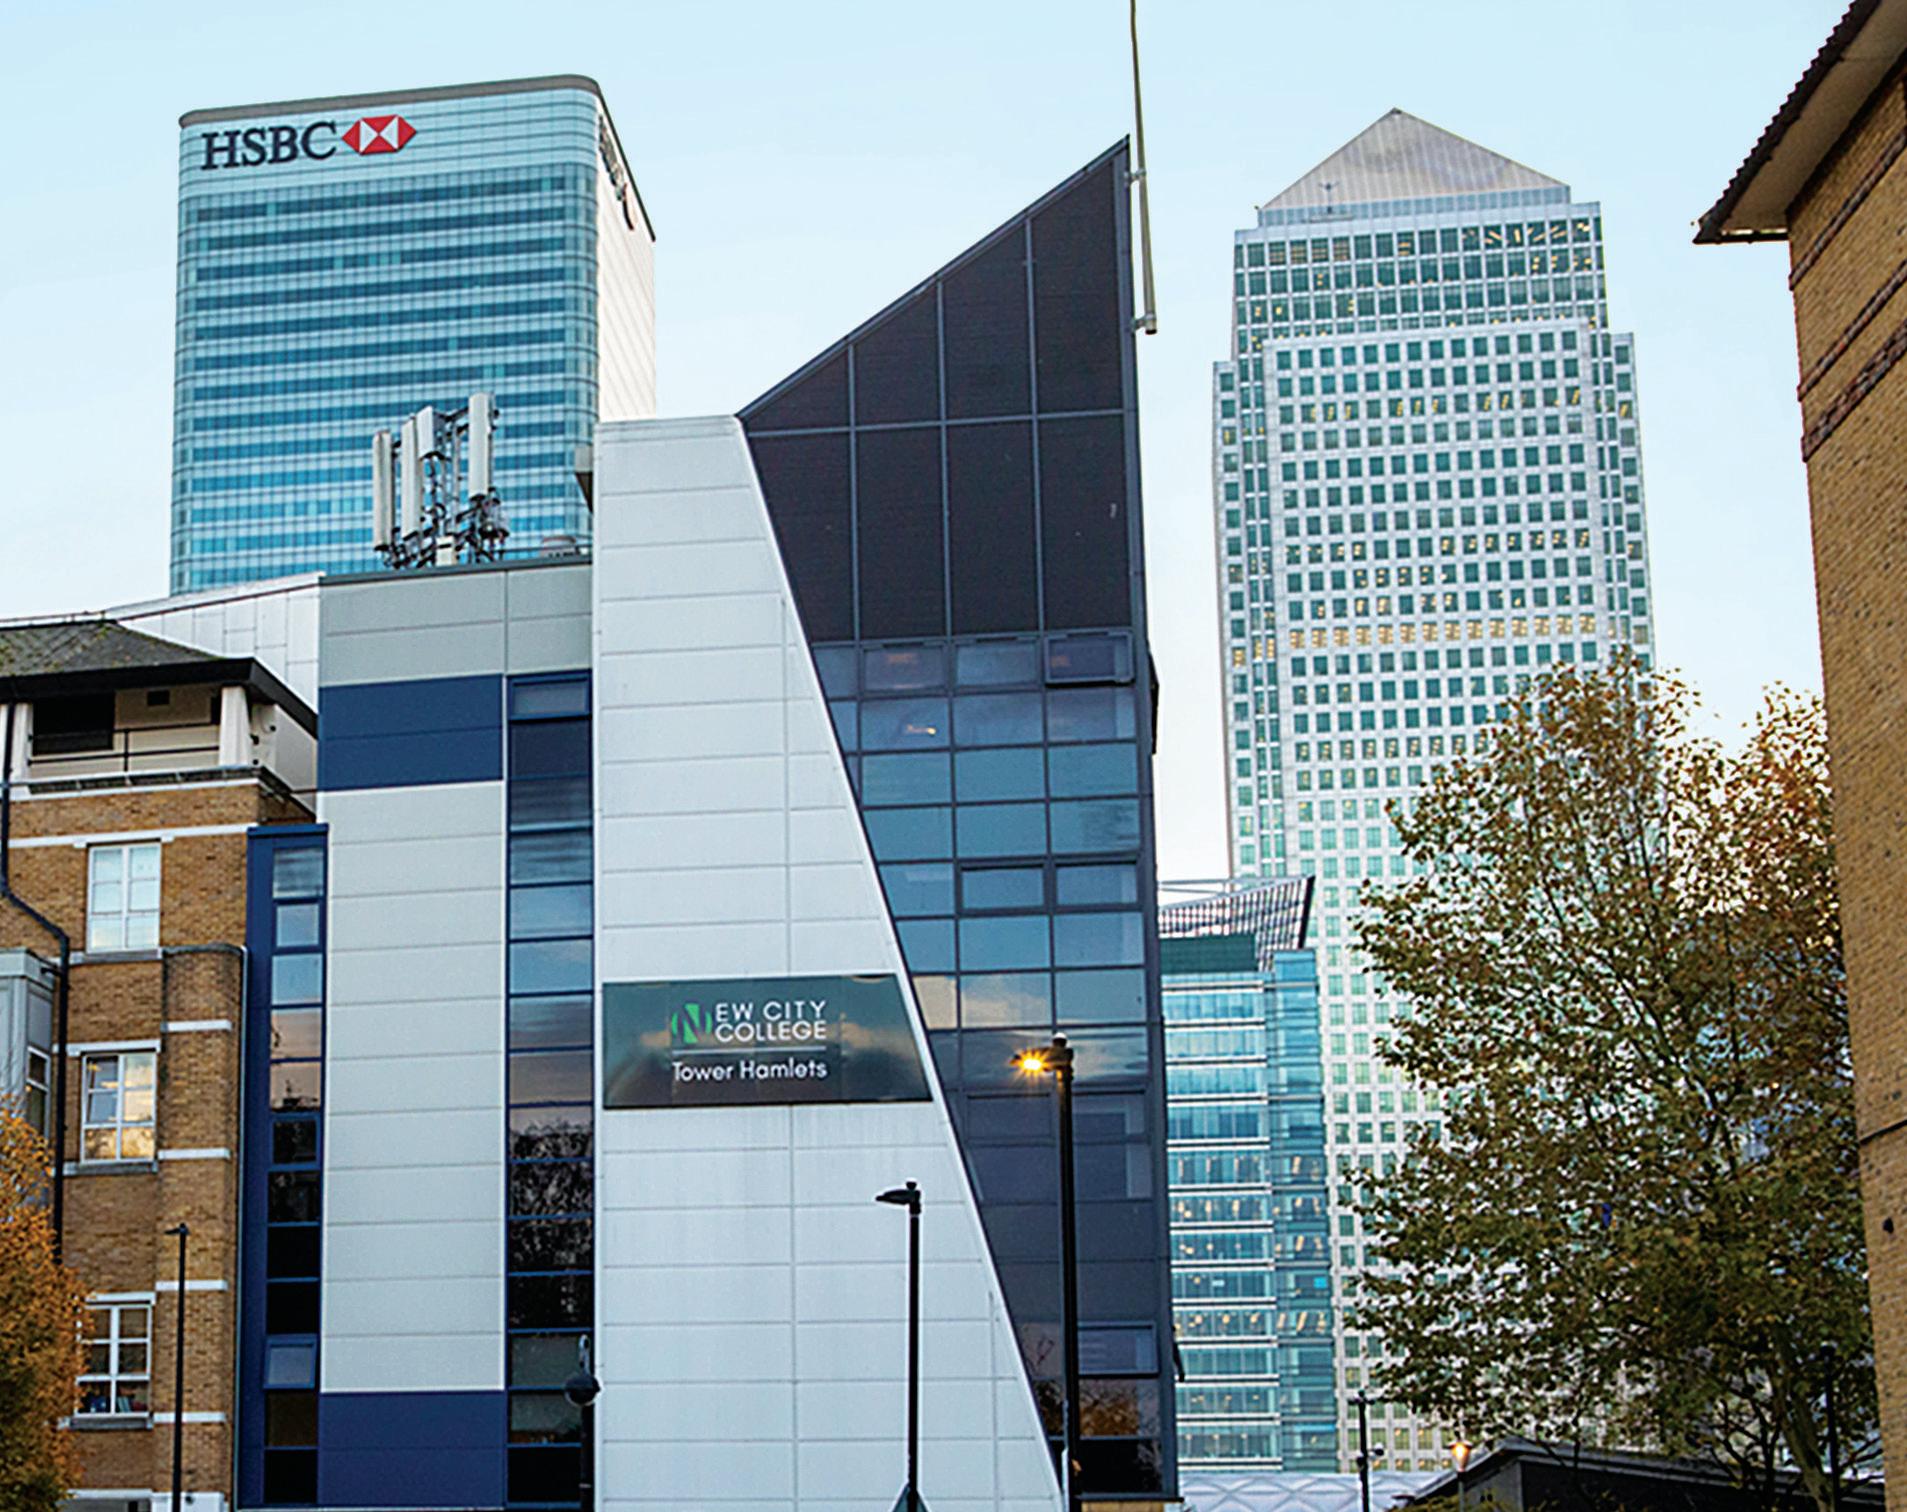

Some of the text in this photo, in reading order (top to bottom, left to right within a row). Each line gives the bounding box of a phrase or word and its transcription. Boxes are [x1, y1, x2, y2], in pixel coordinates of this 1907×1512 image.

[201, 120, 337, 171] HSBC
[763, 1000, 826, 1021] CITY
[714, 1020, 827, 1043] COLLEGE
[671, 1057, 828, 1082] Tower Hamlets
